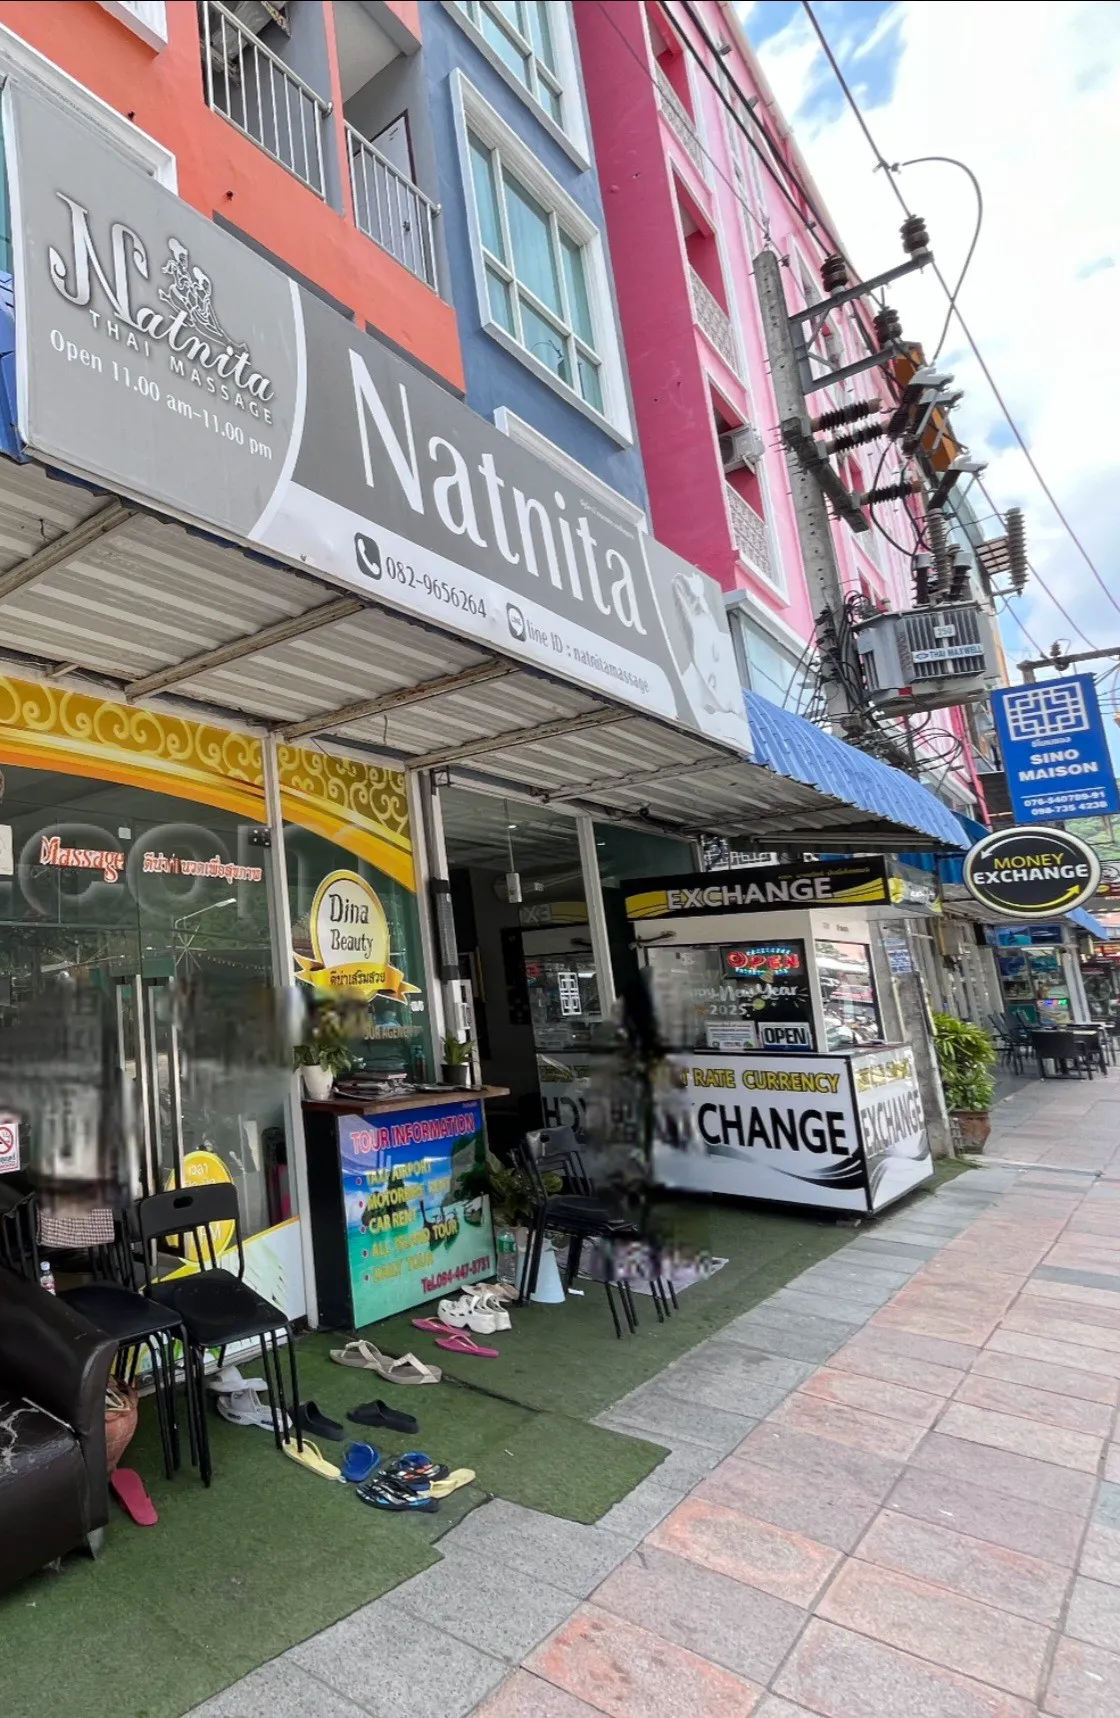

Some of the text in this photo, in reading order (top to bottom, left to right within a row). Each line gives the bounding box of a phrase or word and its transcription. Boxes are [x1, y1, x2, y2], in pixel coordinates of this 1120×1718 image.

[49, 191, 275, 402] Natnita
[89, 309, 273, 425] THAI MASSAGE
[50, 329, 273, 460] Open 11.00 am-11.00 pm
[348, 348, 647, 635] Natnita
[386, 555, 487, 618] 082-9656264
[527, 619, 548, 647] line
[551, 631, 563, 653] ID
[574, 648, 649, 694] natnitamassage
[1018, 761, 1099, 782] MAISON
[1030, 748, 1079, 765] SINO
[40, 835, 125, 884] Massage
[974, 863, 1089, 886] EXCHANGE
[993, 852, 1065, 870] MONEY
[329, 893, 370, 925] Dina
[665, 876, 835, 911] EXCHANGE
[330, 928, 374, 960] Beauty
[727, 950, 800, 970] OPEN
[755, 982, 798, 1001] Year
[709, 1004, 748, 1016] 2025
[764, 1027, 807, 1045] OPEN
[693, 1068, 736, 1089] RATE
[742, 1073, 840, 1094] CURRENCY
[350, 1112, 476, 1155] TOUR INFORMATION
[692, 1102, 850, 1156] CHANGE
[861, 1091, 926, 1155] EXCHANGE
[369, 1208, 418, 1235] CAR RENT
[432, 1218, 459, 1240] TOUR
